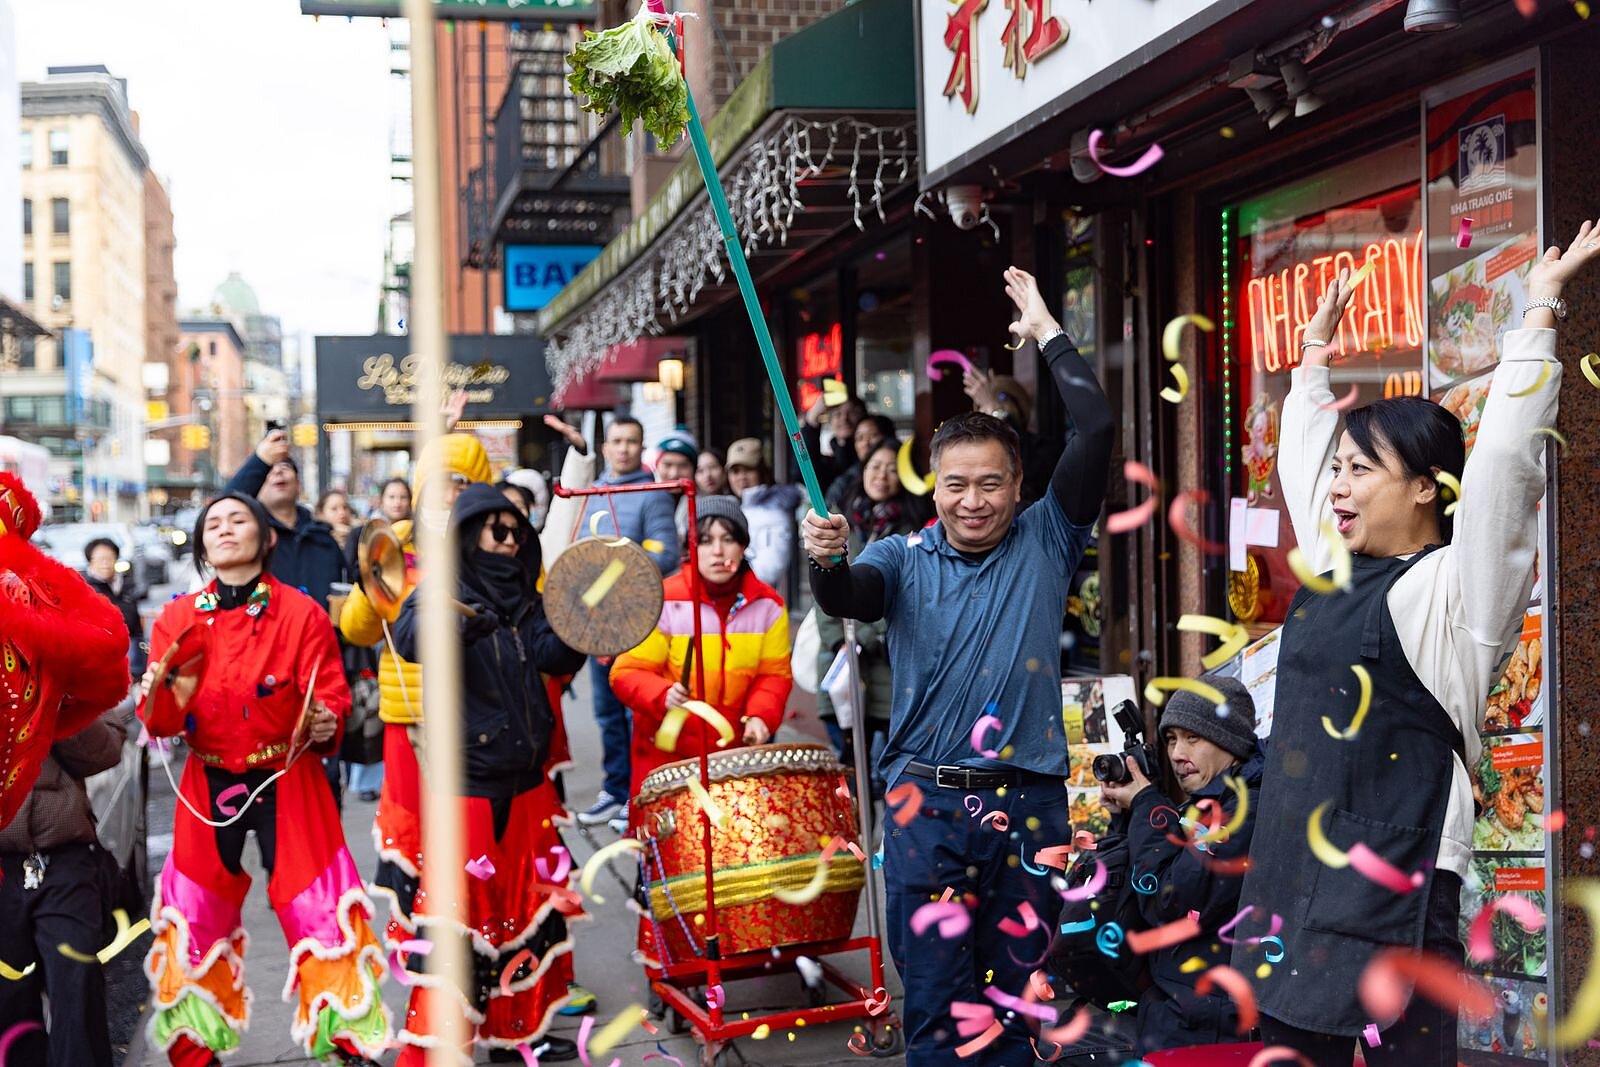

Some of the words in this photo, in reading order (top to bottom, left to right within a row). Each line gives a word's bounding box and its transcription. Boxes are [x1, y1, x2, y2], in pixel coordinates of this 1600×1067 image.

[1450, 202, 1468, 216] NHA
[1468, 193, 1495, 210] TRANG
[1495, 187, 1513, 201] ONE
[515, 263, 586, 289] BA
